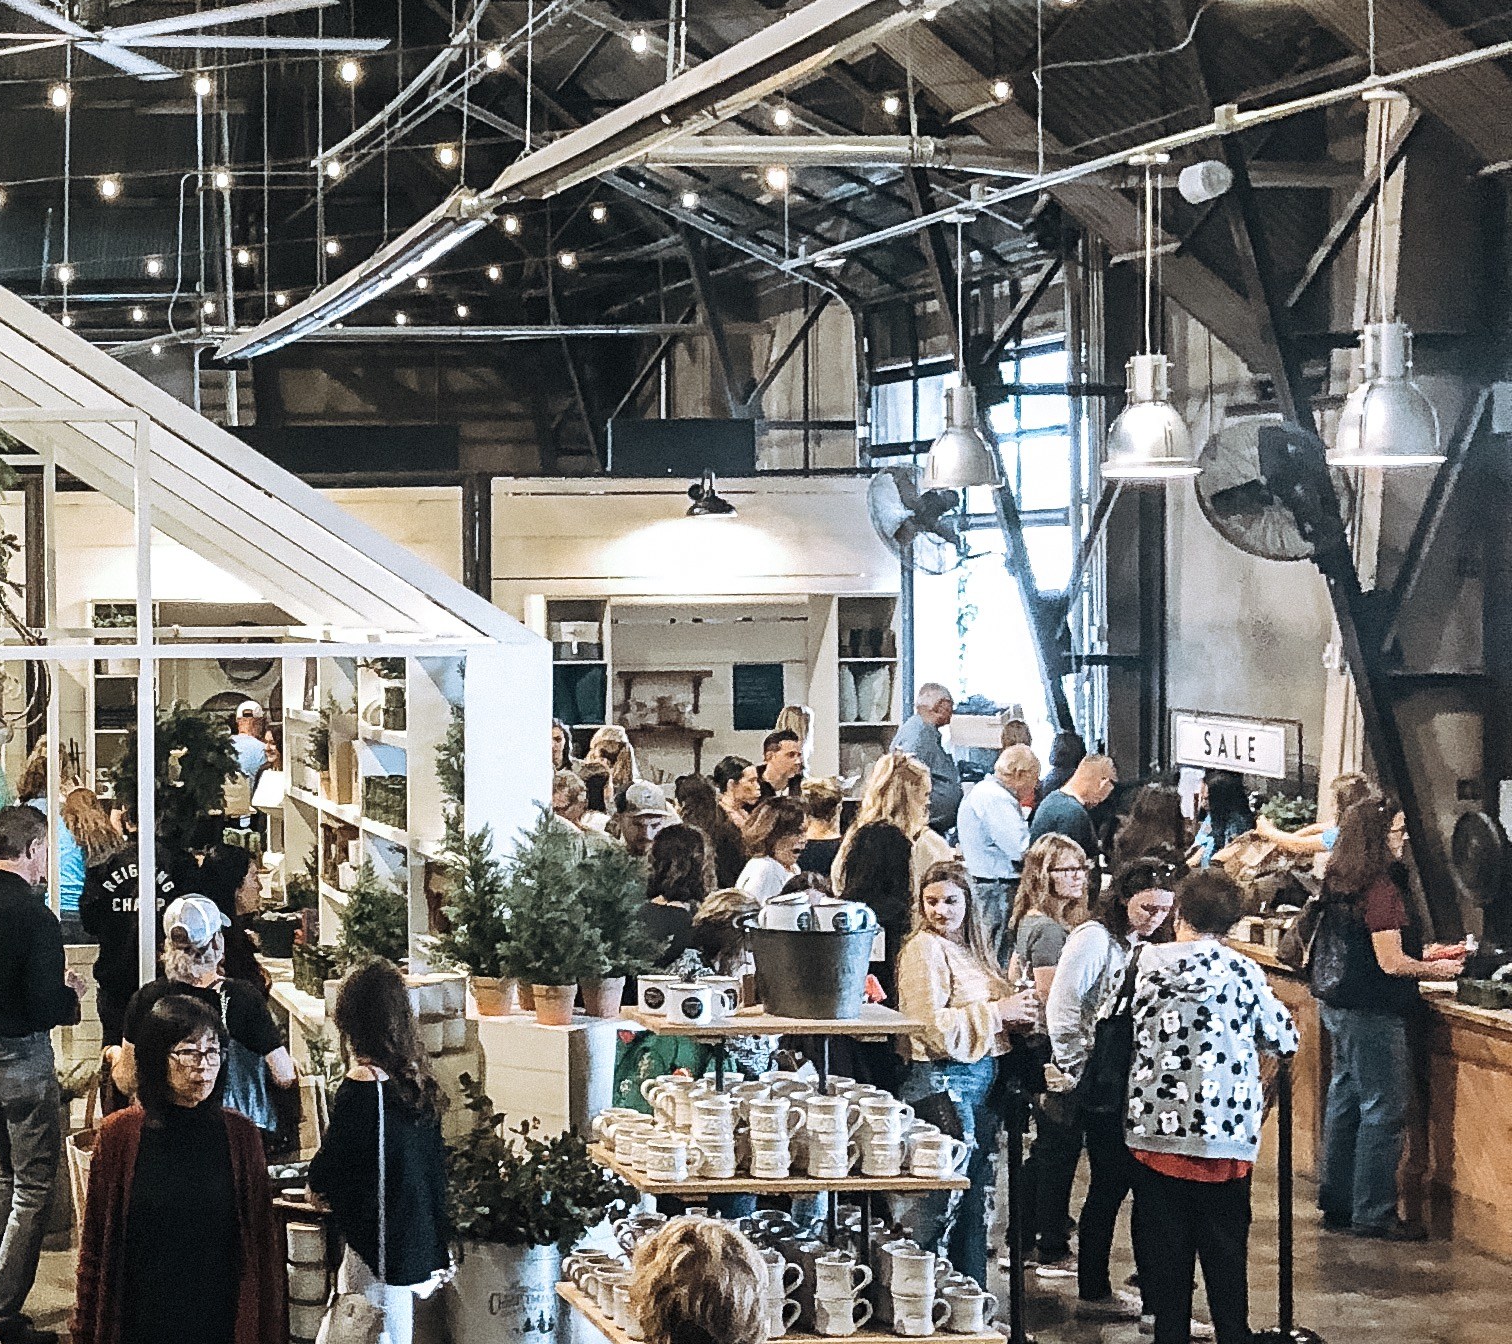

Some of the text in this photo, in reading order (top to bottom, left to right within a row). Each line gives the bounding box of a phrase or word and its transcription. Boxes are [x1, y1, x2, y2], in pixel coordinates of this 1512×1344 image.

[1203, 730, 1256, 763] SALE
[101, 863, 175, 893] REIGNG
[111, 897, 166, 912] CHAP
